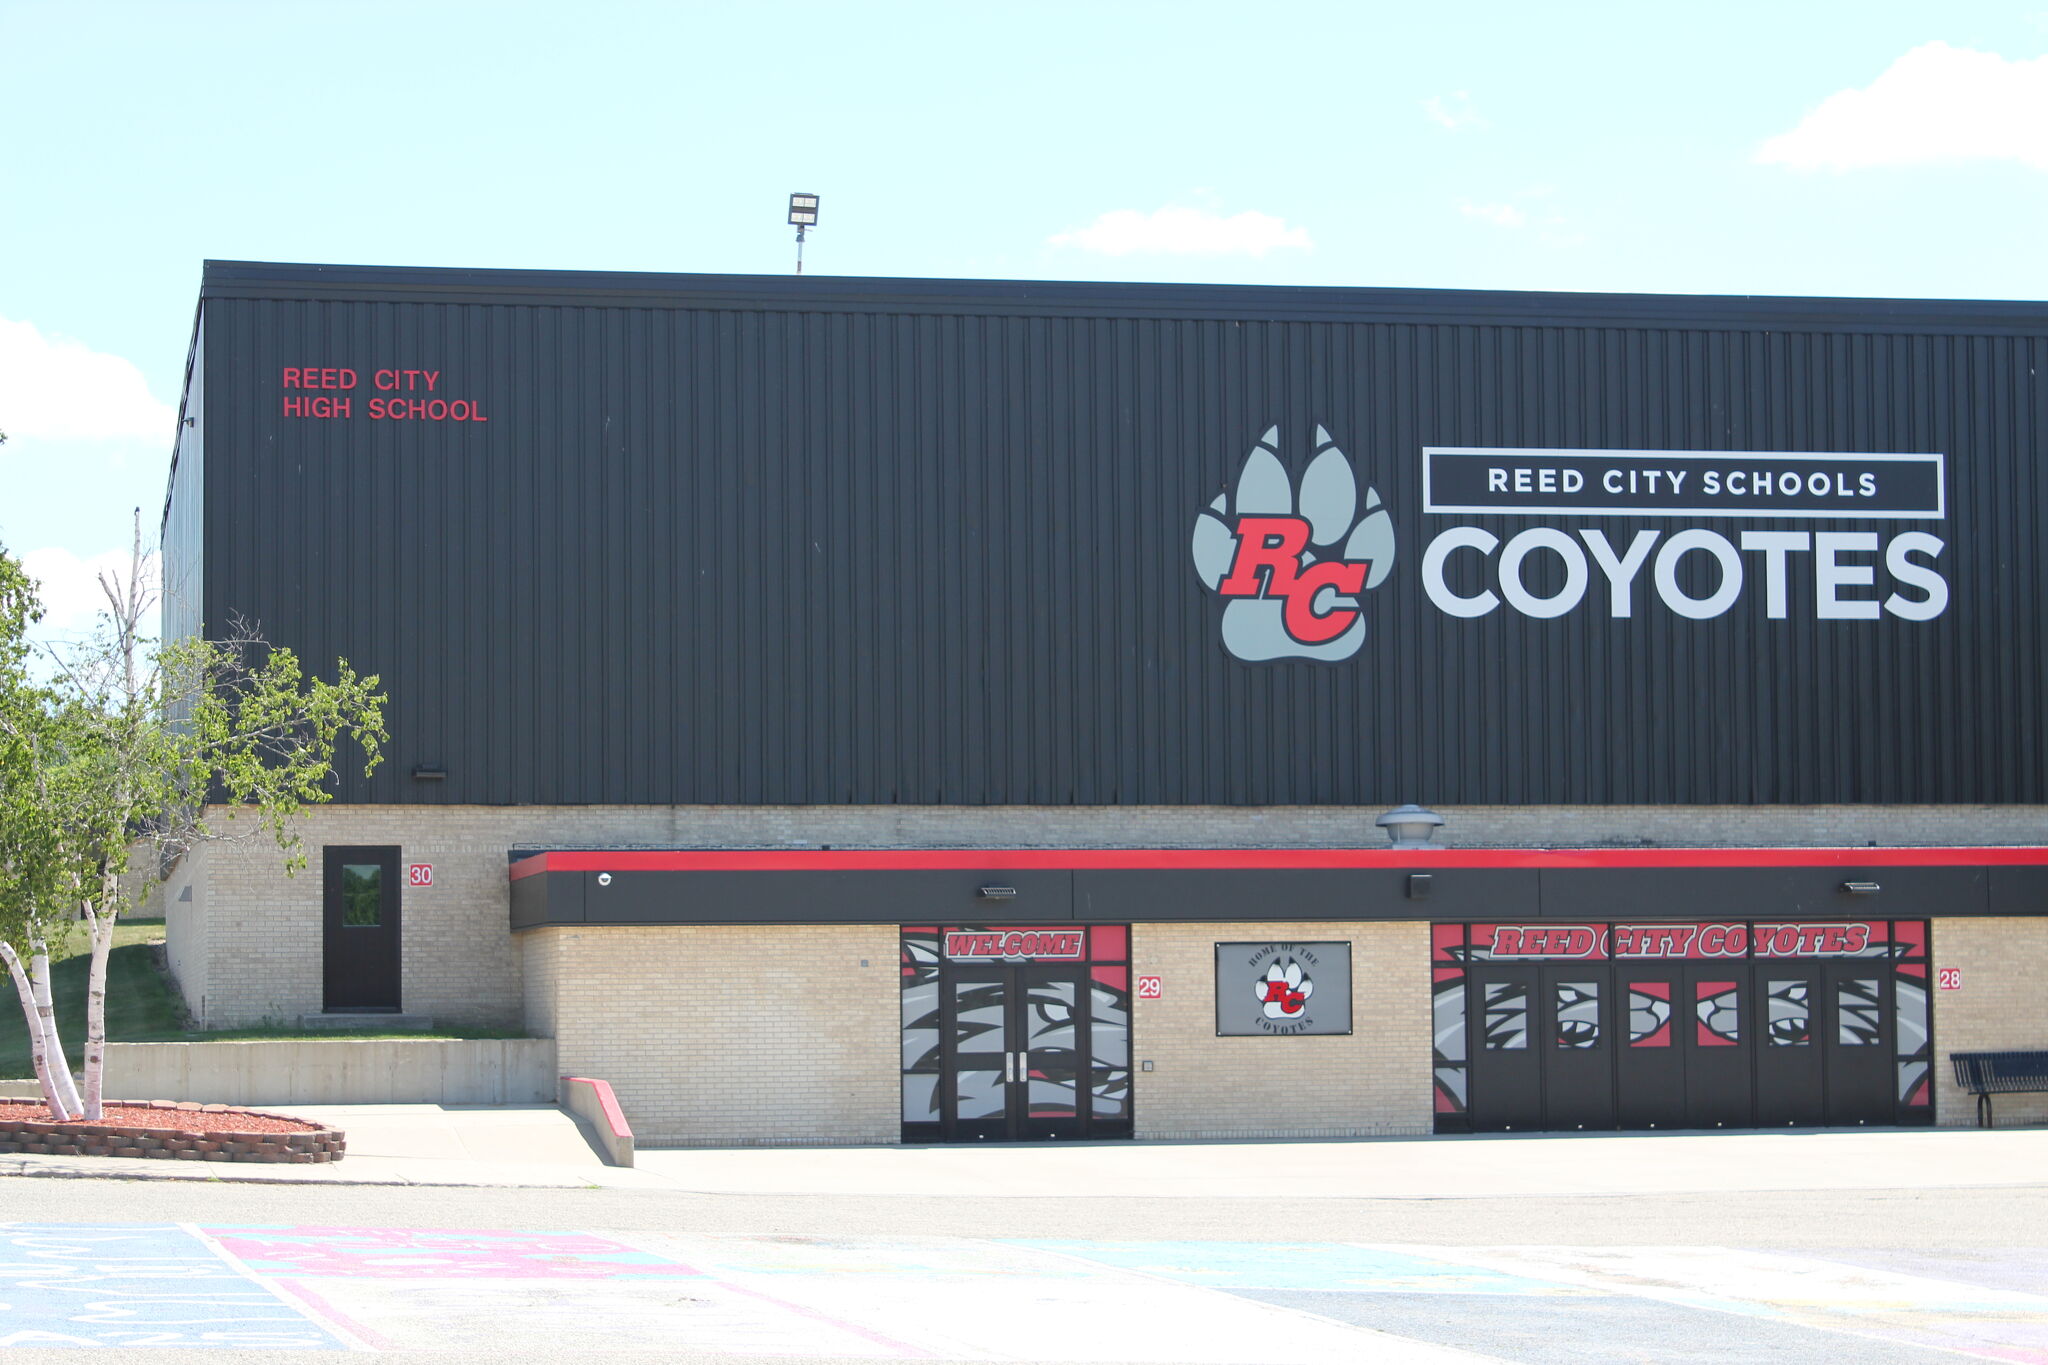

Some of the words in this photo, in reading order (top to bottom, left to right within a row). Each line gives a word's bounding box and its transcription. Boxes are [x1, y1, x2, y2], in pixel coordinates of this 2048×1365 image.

[283, 367, 357, 389] REED
[374, 369, 440, 391] CITY
[283, 396, 350, 418] HIGH
[368, 398, 487, 421] SCHOOL
[1488, 467, 1584, 492] REED
[1602, 469, 1687, 494] CITY
[1702, 471, 1877, 497] SCHOOLS
[1219, 517, 1368, 642] RC
[1421, 525, 1949, 621] COYOTES
[411, 866, 431, 883] 30
[946, 931, 1083, 958] WELCOME
[1490, 926, 1597, 957] REED
[1600, 925, 1697, 957] CITY
[1698, 923, 1870, 957] COYOTES
[1248, 944, 1278, 967] HOME
[1281, 943, 1296, 952] OF
[1300, 946, 1320, 967] THE
[1140, 978, 1160, 996] 29
[1940, 970, 1960, 988] 28
[1256, 1017, 1314, 1034] COYOTES
